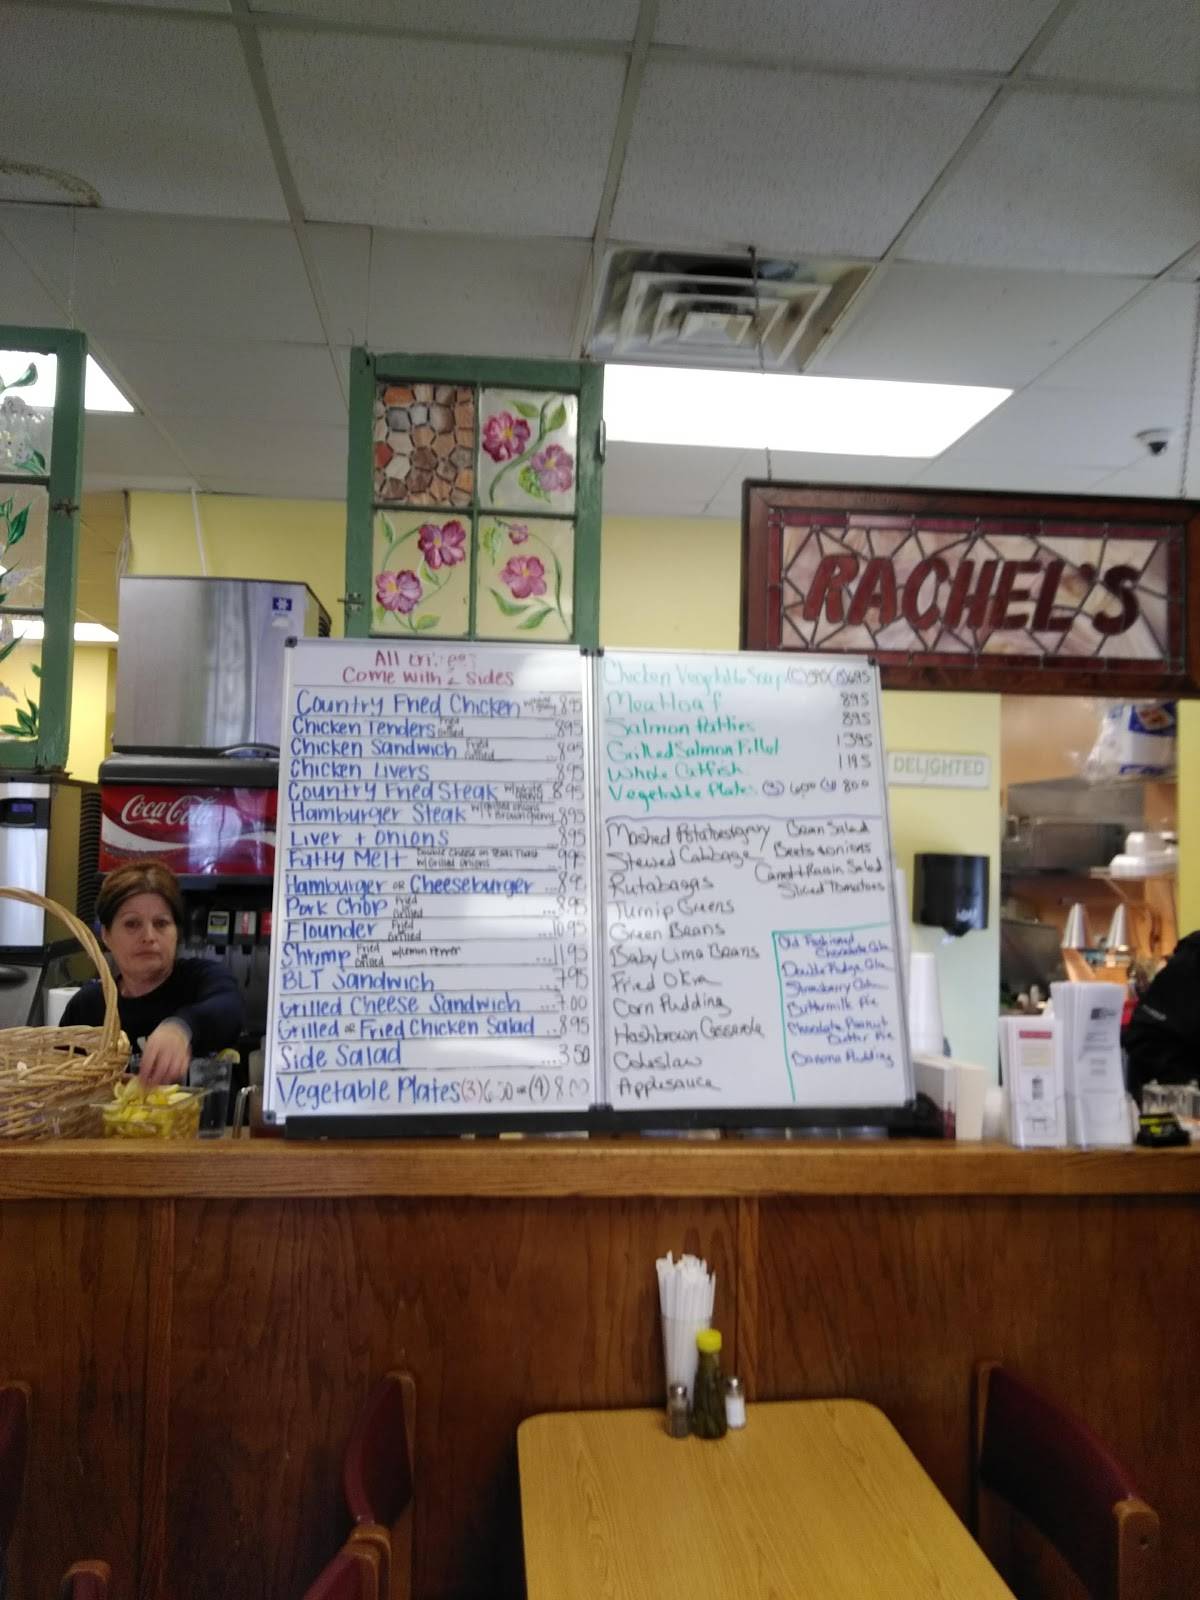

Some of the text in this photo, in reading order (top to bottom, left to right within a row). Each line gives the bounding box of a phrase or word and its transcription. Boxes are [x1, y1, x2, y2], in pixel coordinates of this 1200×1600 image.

[802, 552, 1141, 636] RACHEL'S
[375, 649, 399, 666] All
[342, 666, 395, 685] Come
[403, 669, 441, 686] with
[296, 689, 521, 719] Country Fried Chicken
[292, 717, 435, 738] Chicken Tenders
[605, 716, 690, 738] Salmon
[290, 738, 457, 760] Chicken Sandwich
[606, 739, 674, 763] Grilled
[674, 738, 734, 759] Salmon
[290, 759, 362, 780] Chicken
[373, 760, 430, 781] Livers
[674, 759, 744, 781] Catfish
[892, 756, 985, 778] DELIGHTED
[288, 780, 377, 803] Country
[385, 780, 434, 801] Fried
[438, 780, 499, 802] Steak
[607, 783, 702, 813] Vegetable
[290, 802, 401, 827] Hamburger
[411, 801, 467, 826] Steak
[290, 829, 341, 848] Liver
[375, 828, 450, 849] Onions
[606, 822, 671, 849] Mashed
[288, 849, 408, 873] Patty Melt
[606, 845, 764, 873] Stewed Cabbage
[284, 874, 388, 898] Hamburger
[409, 873, 534, 899] Cheeseburger
[284, 897, 327, 918] Pork
[336, 893, 388, 918] Chop
[395, 894, 418, 905] Fried
[607, 897, 735, 922] Turnip Greens
[285, 919, 378, 941] Flounder
[391, 918, 414, 930] Fried
[609, 921, 726, 943] Green Beans
[281, 943, 352, 970] Shrimp
[356, 943, 380, 954] Fried
[609, 941, 761, 970] Baby Lima Beans
[282, 968, 435, 992] BLT Sandwich
[610, 968, 723, 993] Fried Okra
[280, 991, 520, 1017] Grilled Cheese Sandwich
[612, 991, 732, 1018] Corn Pudding
[278, 1017, 340, 1041] Grilled
[360, 1017, 405, 1040] Fried
[409, 1017, 479, 1038] Chicken
[486, 1015, 535, 1036] Salad
[613, 1021, 700, 1046] Hashbrown
[280, 1040, 402, 1069] Side Salad
[276, 1075, 391, 1110] Vegetable
[397, 1073, 460, 1104] Plates
